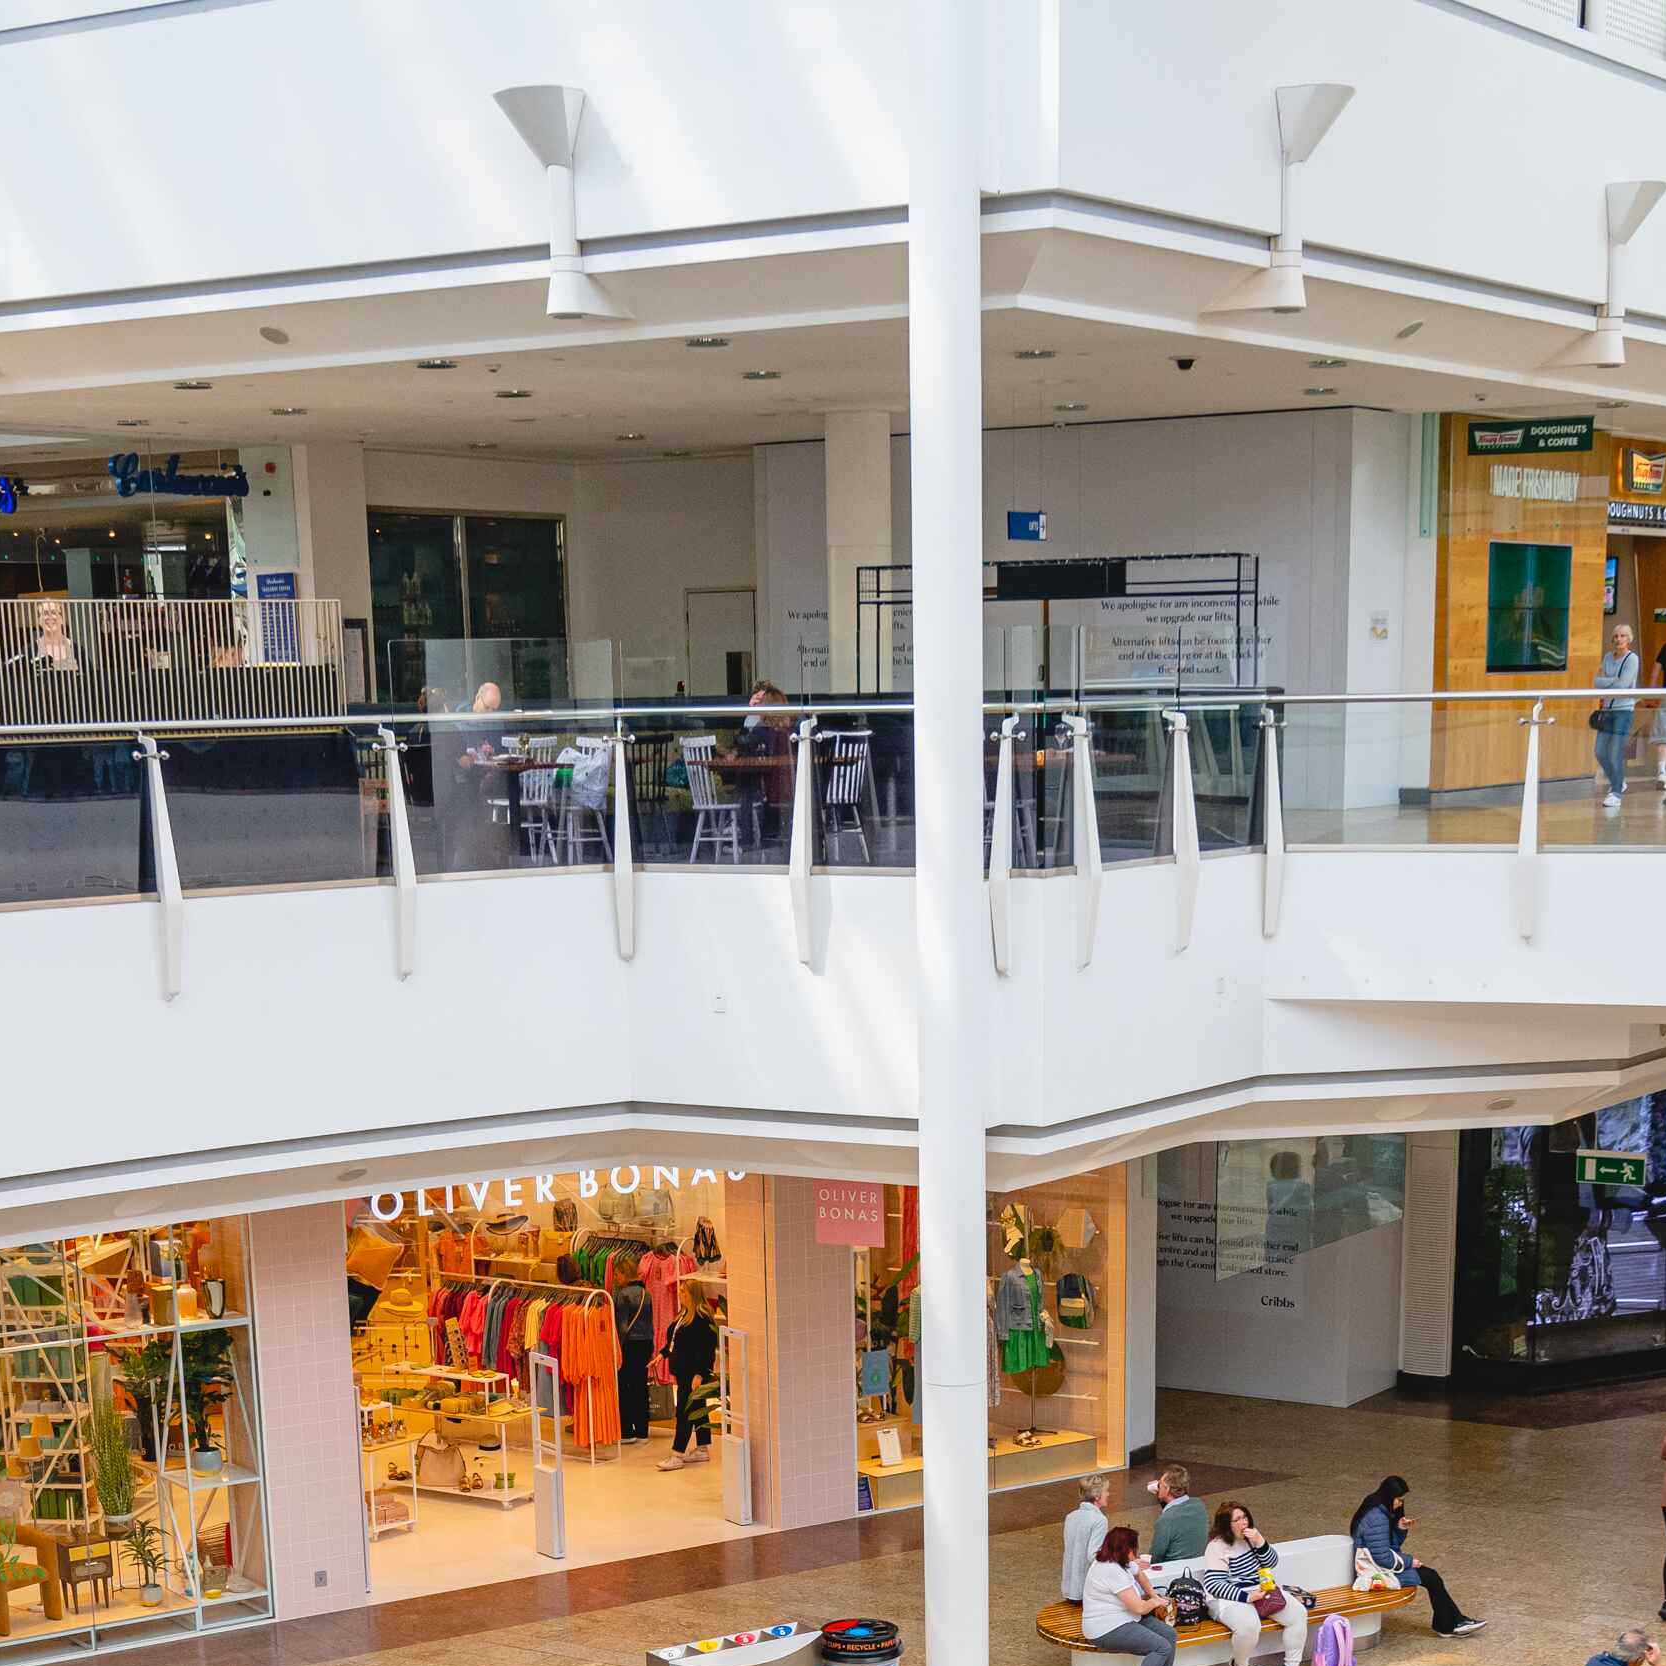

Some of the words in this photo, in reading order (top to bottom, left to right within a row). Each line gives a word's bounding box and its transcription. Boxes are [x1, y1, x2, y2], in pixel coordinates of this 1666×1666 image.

[1531, 424, 1588, 436] DOUGHNUTS
[1538, 439, 1545, 448] &
[1547, 436, 1579, 447] COFFEE
[1101, 600, 1115, 611] We
[1117, 599, 1157, 612] apologise
[1159, 600, 1172, 609] for
[788, 608, 800, 620] We
[802, 608, 829, 621] apolog
[1146, 614, 1158, 623] we
[1160, 613, 1195, 625] upgrade
[1197, 614, 1212, 623] our
[1111, 636, 1156, 648] Alternative
[797, 644, 829, 656] Alternati
[1118, 650, 1130, 661] end
[1133, 650, 1144, 661] of
[370, 1174, 556, 1221] OLIVER
[819, 1188, 877, 1204] OLIVER
[1183, 1199, 1195, 1209] for
[819, 1206, 878, 1222] BONAS
[1172, 1232, 1188, 1243] lifts
[1190, 1236, 1204, 1244] can
[1281, 1243, 1299, 1251] end
[1182, 1246, 1199, 1256] and
[1171, 1259, 1184, 1267] the
[1264, 1267, 1289, 1277] store.
[1261, 1295, 1296, 1309] Cribbs
[846, 1643, 876, 1651] RECYCLE
